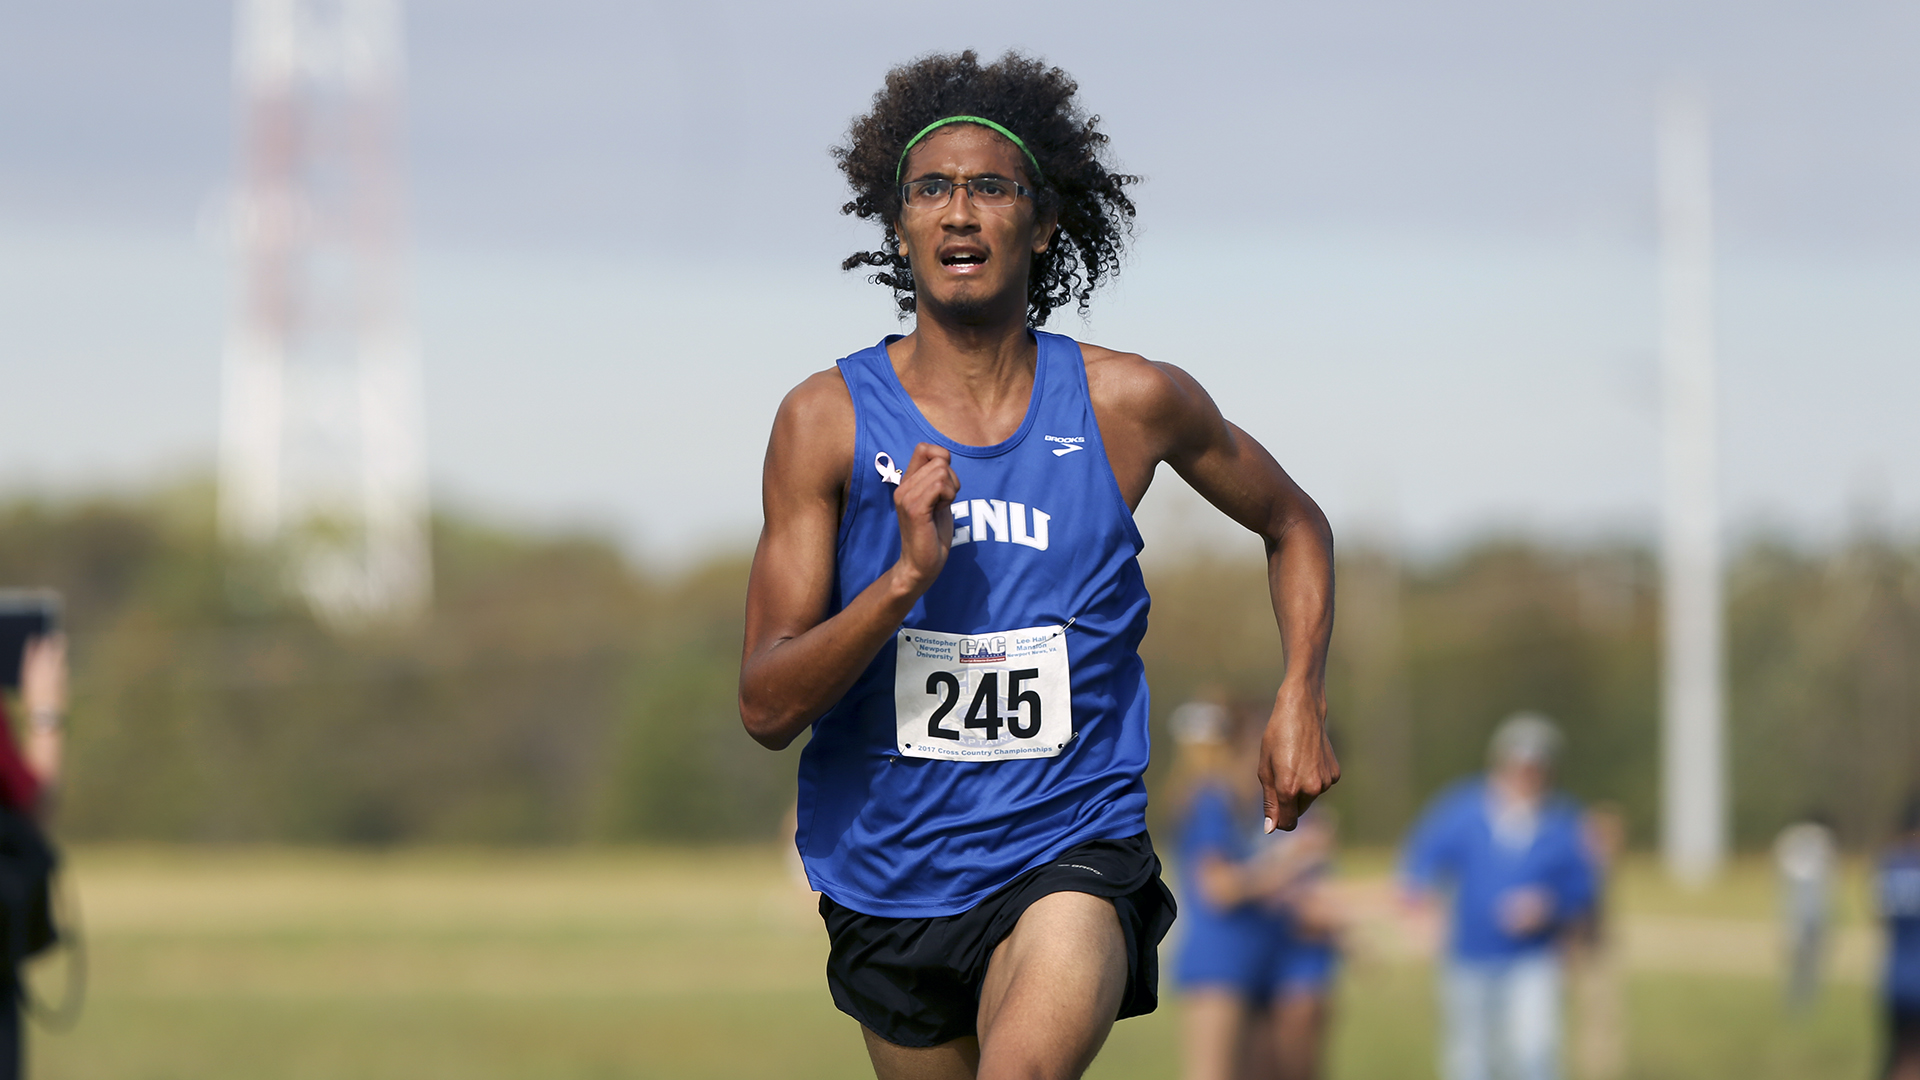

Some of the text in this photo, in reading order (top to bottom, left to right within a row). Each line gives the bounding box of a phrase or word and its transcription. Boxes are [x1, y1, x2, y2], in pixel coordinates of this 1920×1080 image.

[1044, 434, 1085, 443] BROOKS
[950, 499, 1051, 551] CNU
[914, 636, 957, 647] Christopher
[959, 636, 1006, 656] CAC
[1016, 643, 1047, 651] Mansion
[919, 644, 951, 653] Newport
[916, 651, 954, 661] University
[926, 668, 1042, 740] 245
[958, 735, 1014, 746] APTAIN
[917, 745, 1053, 757] 2017 Cross Country Championships
